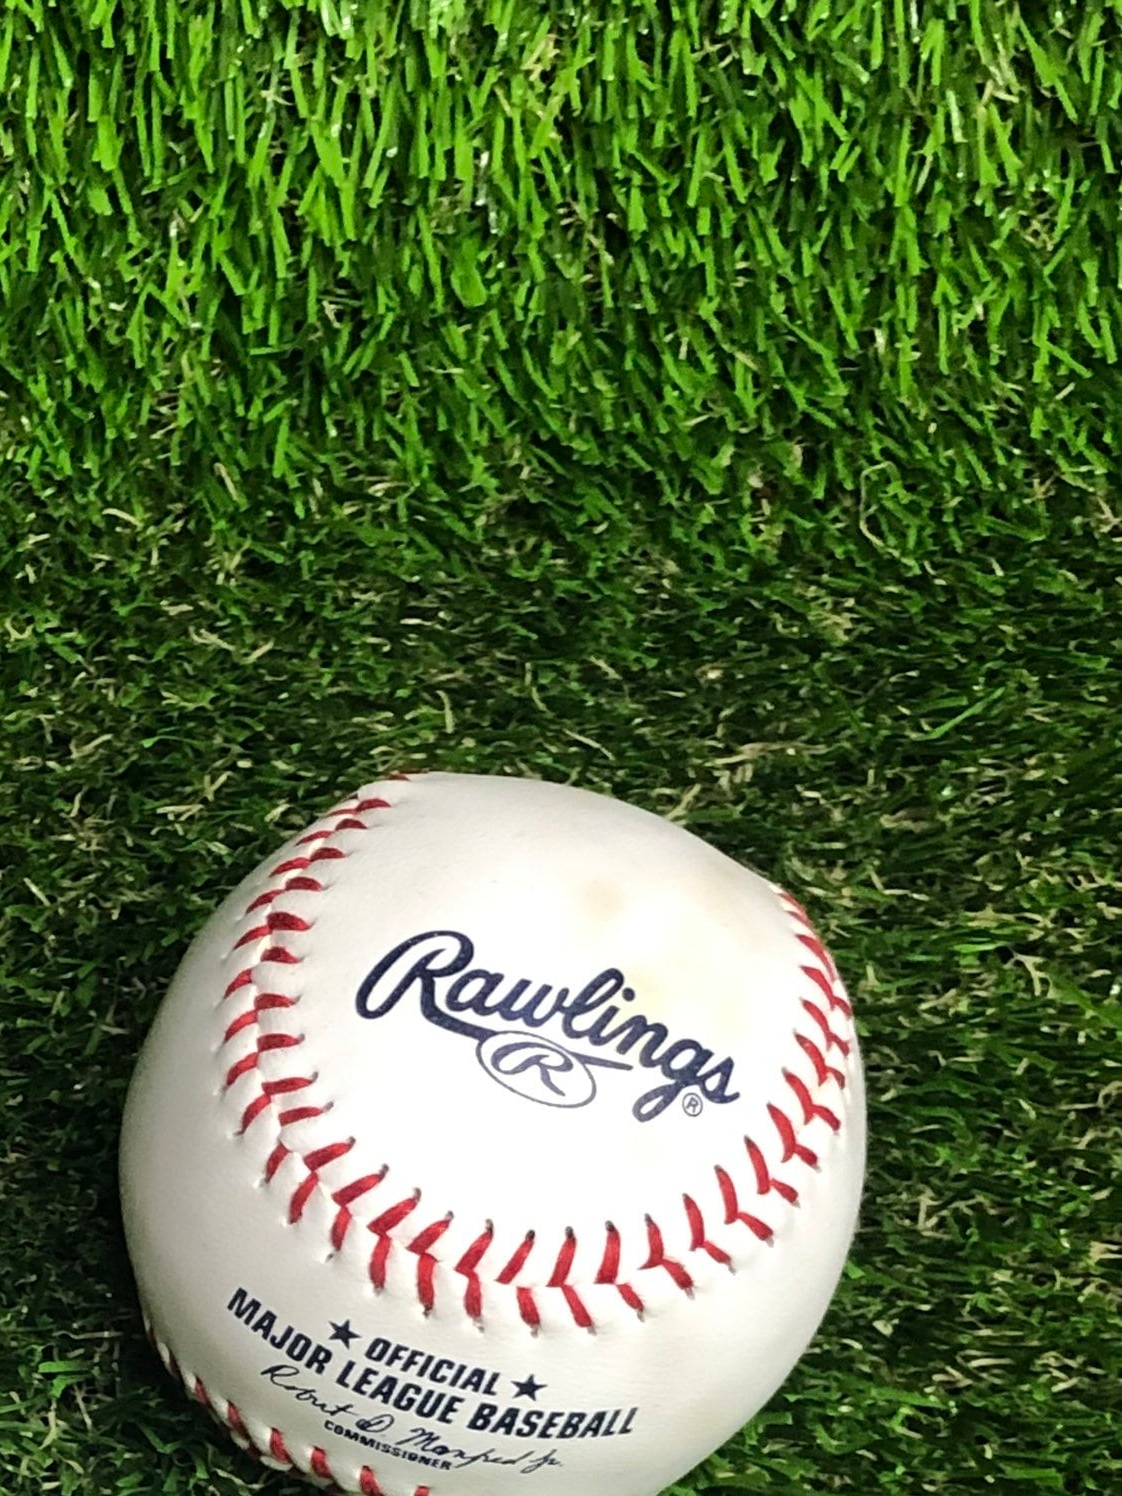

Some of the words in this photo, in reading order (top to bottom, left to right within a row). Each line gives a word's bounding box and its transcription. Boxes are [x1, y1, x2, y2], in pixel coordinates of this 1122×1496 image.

[355, 930, 740, 1122] Rawlings
[227, 1287, 334, 1376] MAJOR
[336, 1359, 465, 1425] LEAGUE
[467, 1402, 639, 1440] BASEBALL
[364, 1338, 502, 1396] OFFICIAL
[323, 1419, 452, 1471] COMMISSIONER
